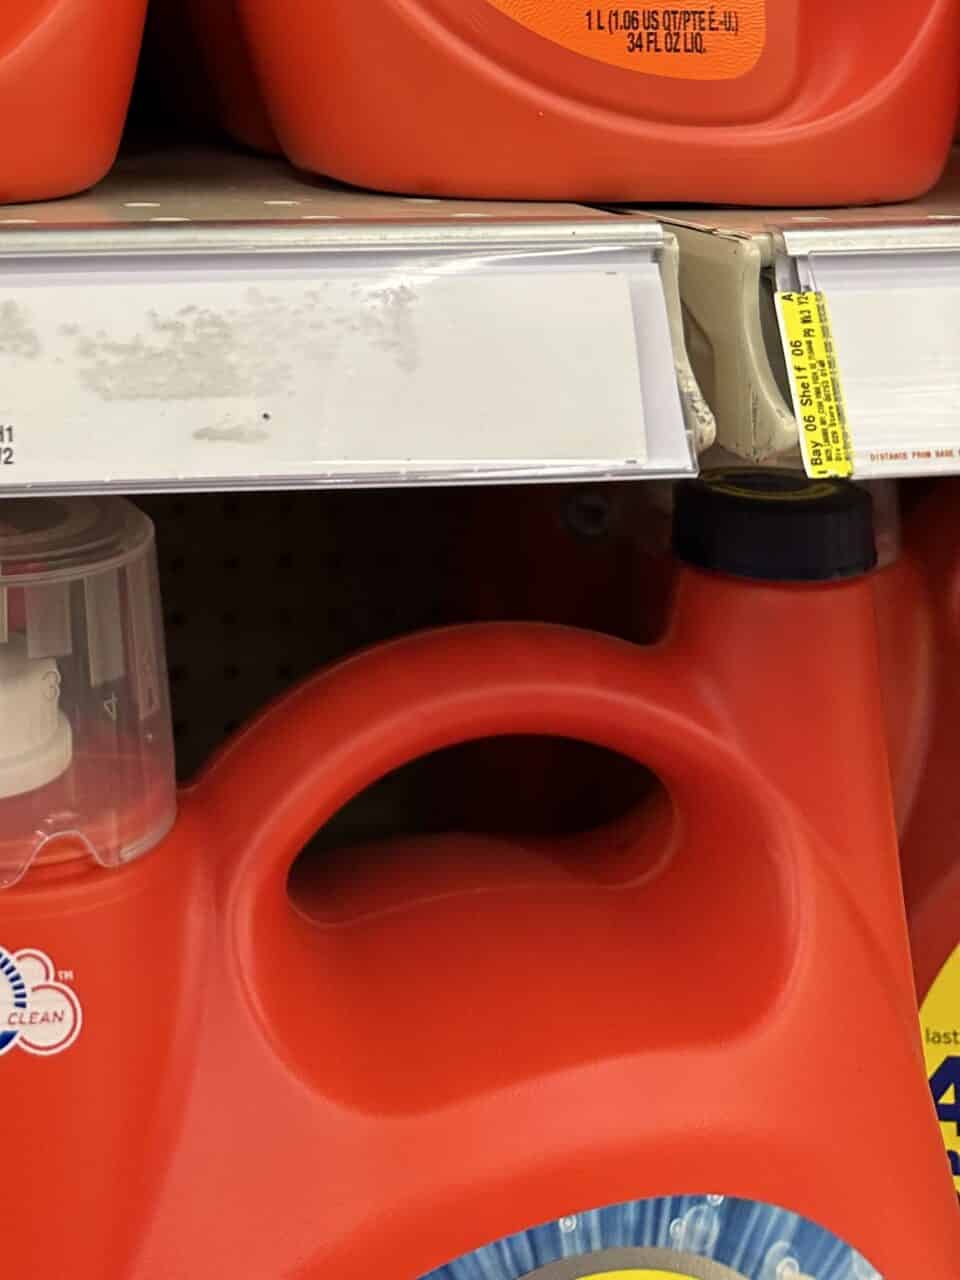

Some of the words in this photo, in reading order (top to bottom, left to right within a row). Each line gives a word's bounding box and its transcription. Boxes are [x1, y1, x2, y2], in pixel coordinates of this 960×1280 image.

[585, 10, 592, 31] 1
[597, 10, 604, 30] L
[608, 10, 639, 35] (1.06
[642, 10, 659, 31] US
[627, 32, 643, 52] 34
[646, 32, 661, 52] FL
[664, 32, 680, 52] OZ
[684, 33, 706, 54] LIQ.
[790, 339, 804, 356] 06
[795, 365, 813, 406] Shelf
[804, 415, 817, 431] 06
[811, 440, 824, 465] Bay
[7, 1010, 65, 1025] CLEAN
